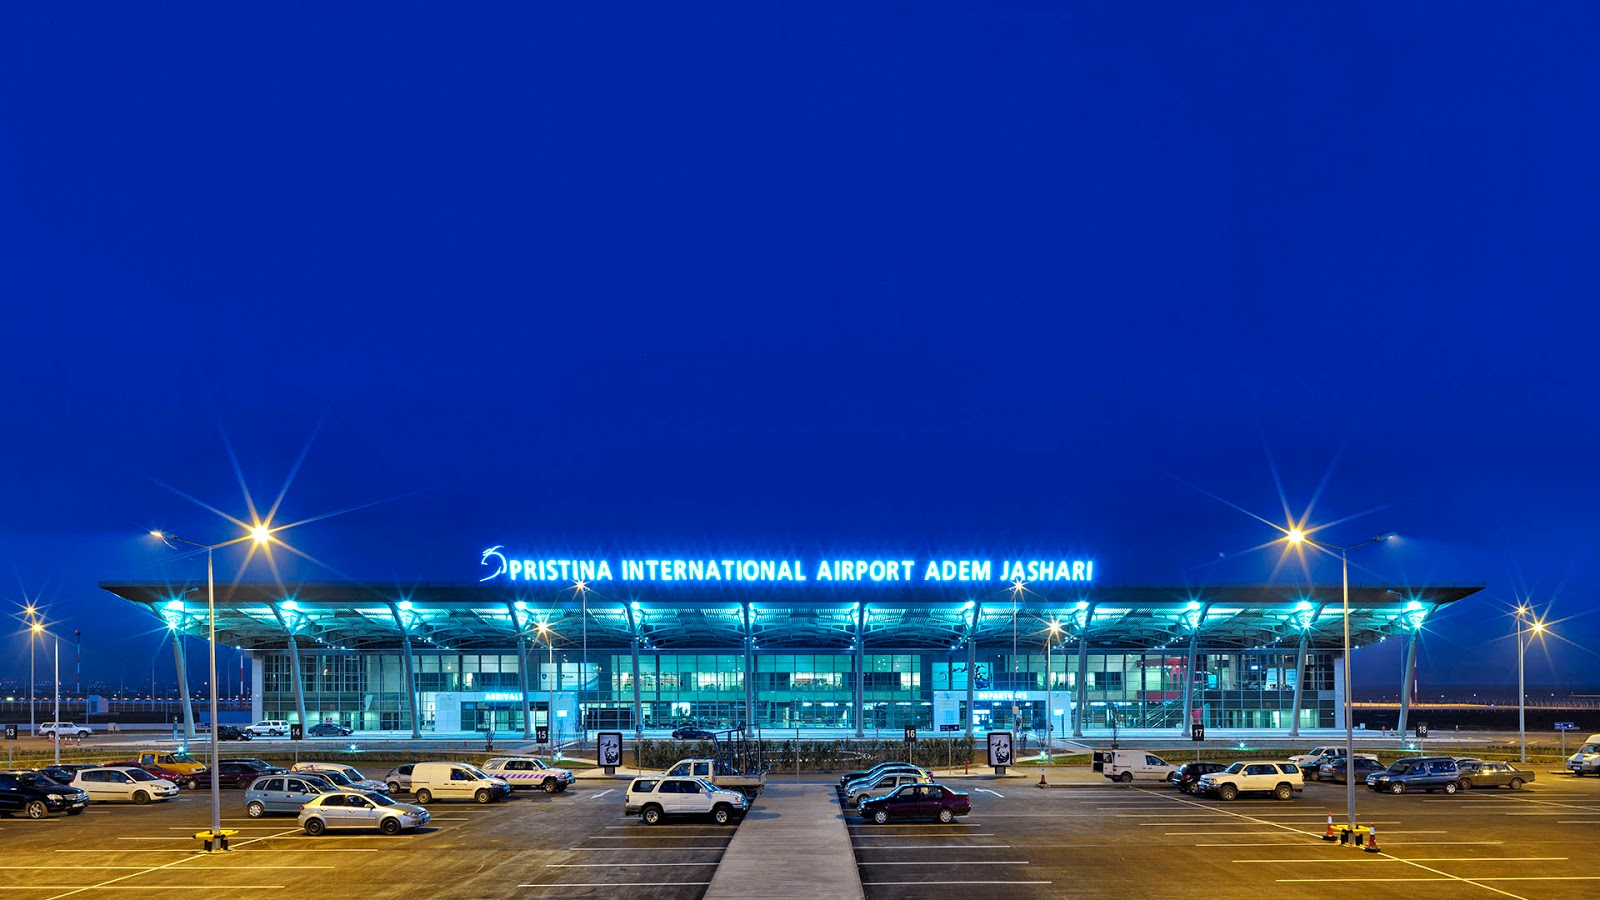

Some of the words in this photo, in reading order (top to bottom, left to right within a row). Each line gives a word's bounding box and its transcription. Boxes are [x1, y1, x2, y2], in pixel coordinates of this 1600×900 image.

[508, 559, 613, 581] PRISTINA
[621, 559, 807, 581] INTERNATIONAL
[816, 560, 915, 581] AIRPORT
[924, 560, 991, 581] ADEM
[999, 560, 1093, 582] JASHARI
[5, 728, 15, 736] 13
[291, 727, 301, 736] 14
[905, 729, 916, 739] 16
[1194, 728, 1204, 738] 17
[1418, 725, 1427, 734] 18
[537, 730, 547, 740] 15
